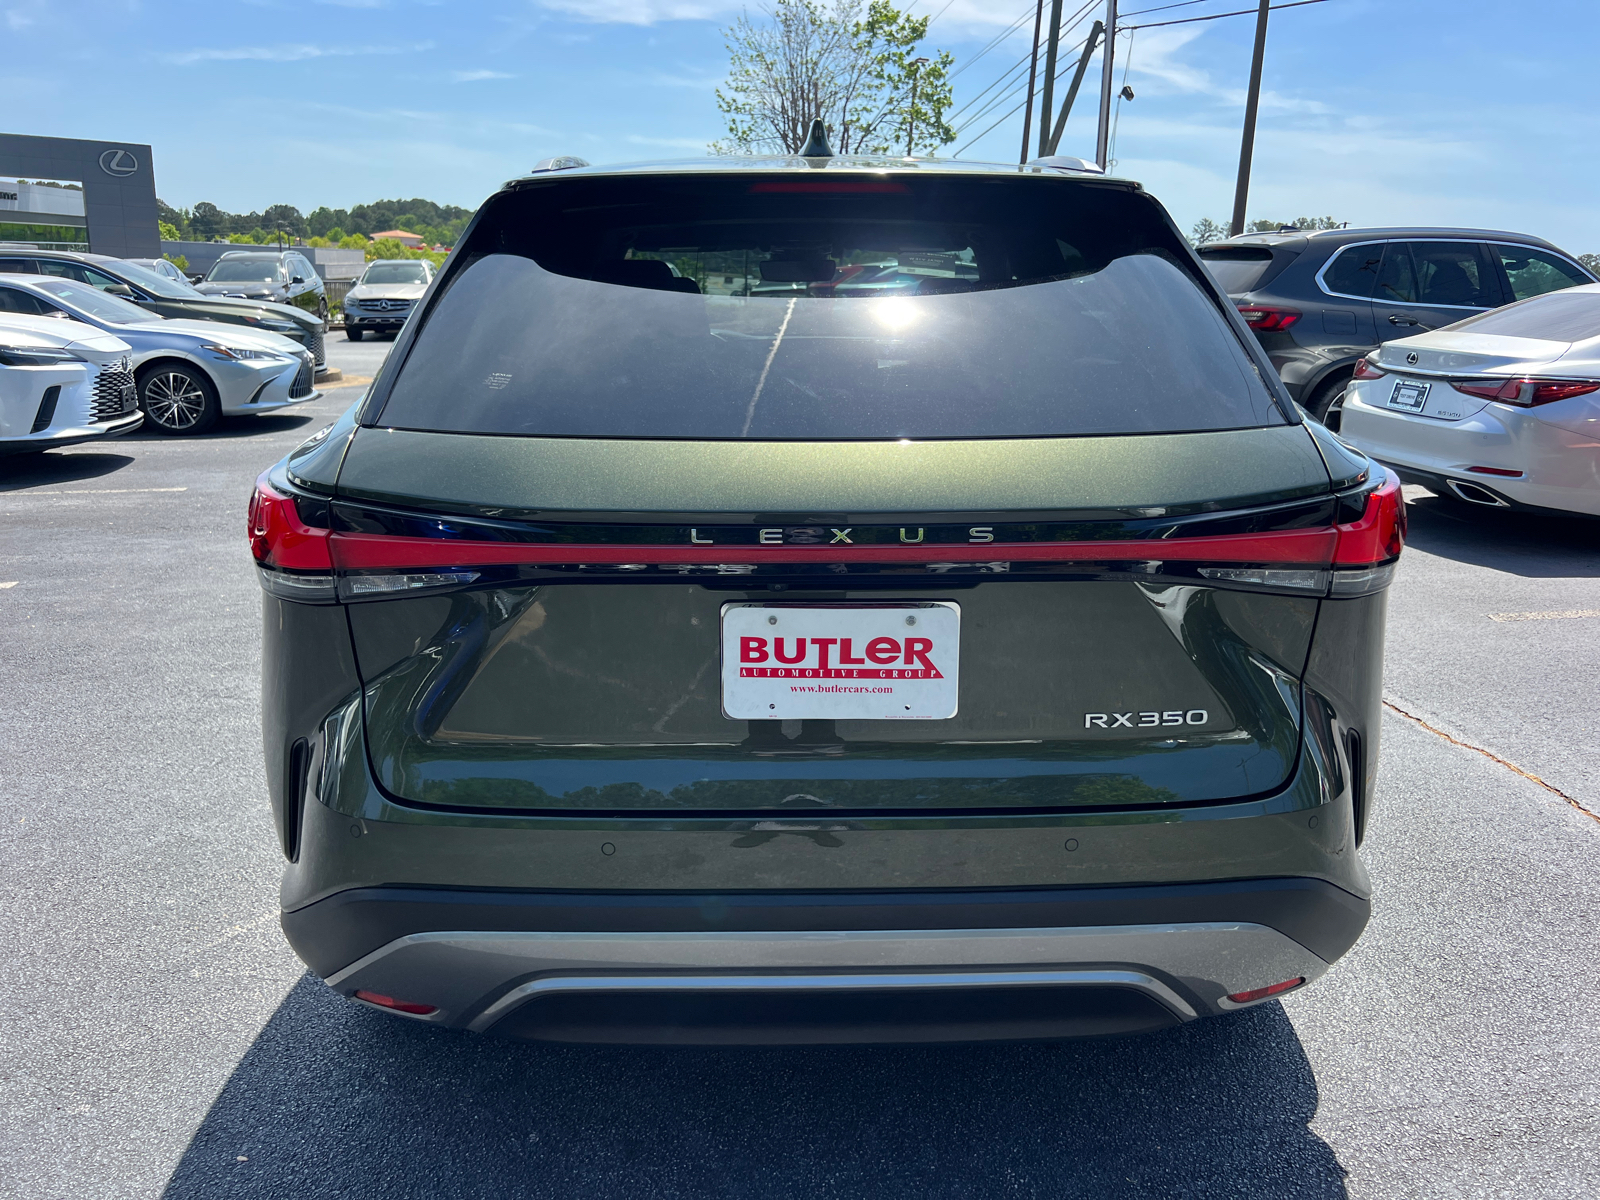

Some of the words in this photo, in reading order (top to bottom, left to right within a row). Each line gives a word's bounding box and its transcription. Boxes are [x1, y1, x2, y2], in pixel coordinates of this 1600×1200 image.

[691, 527, 995, 545] LEXUS
[740, 668, 859, 678] AUTOMOTIVE
[879, 669, 938, 679] GROUP
[790, 684, 893, 695] www.butlercars.com
[1084, 709, 1209, 729] RX350
